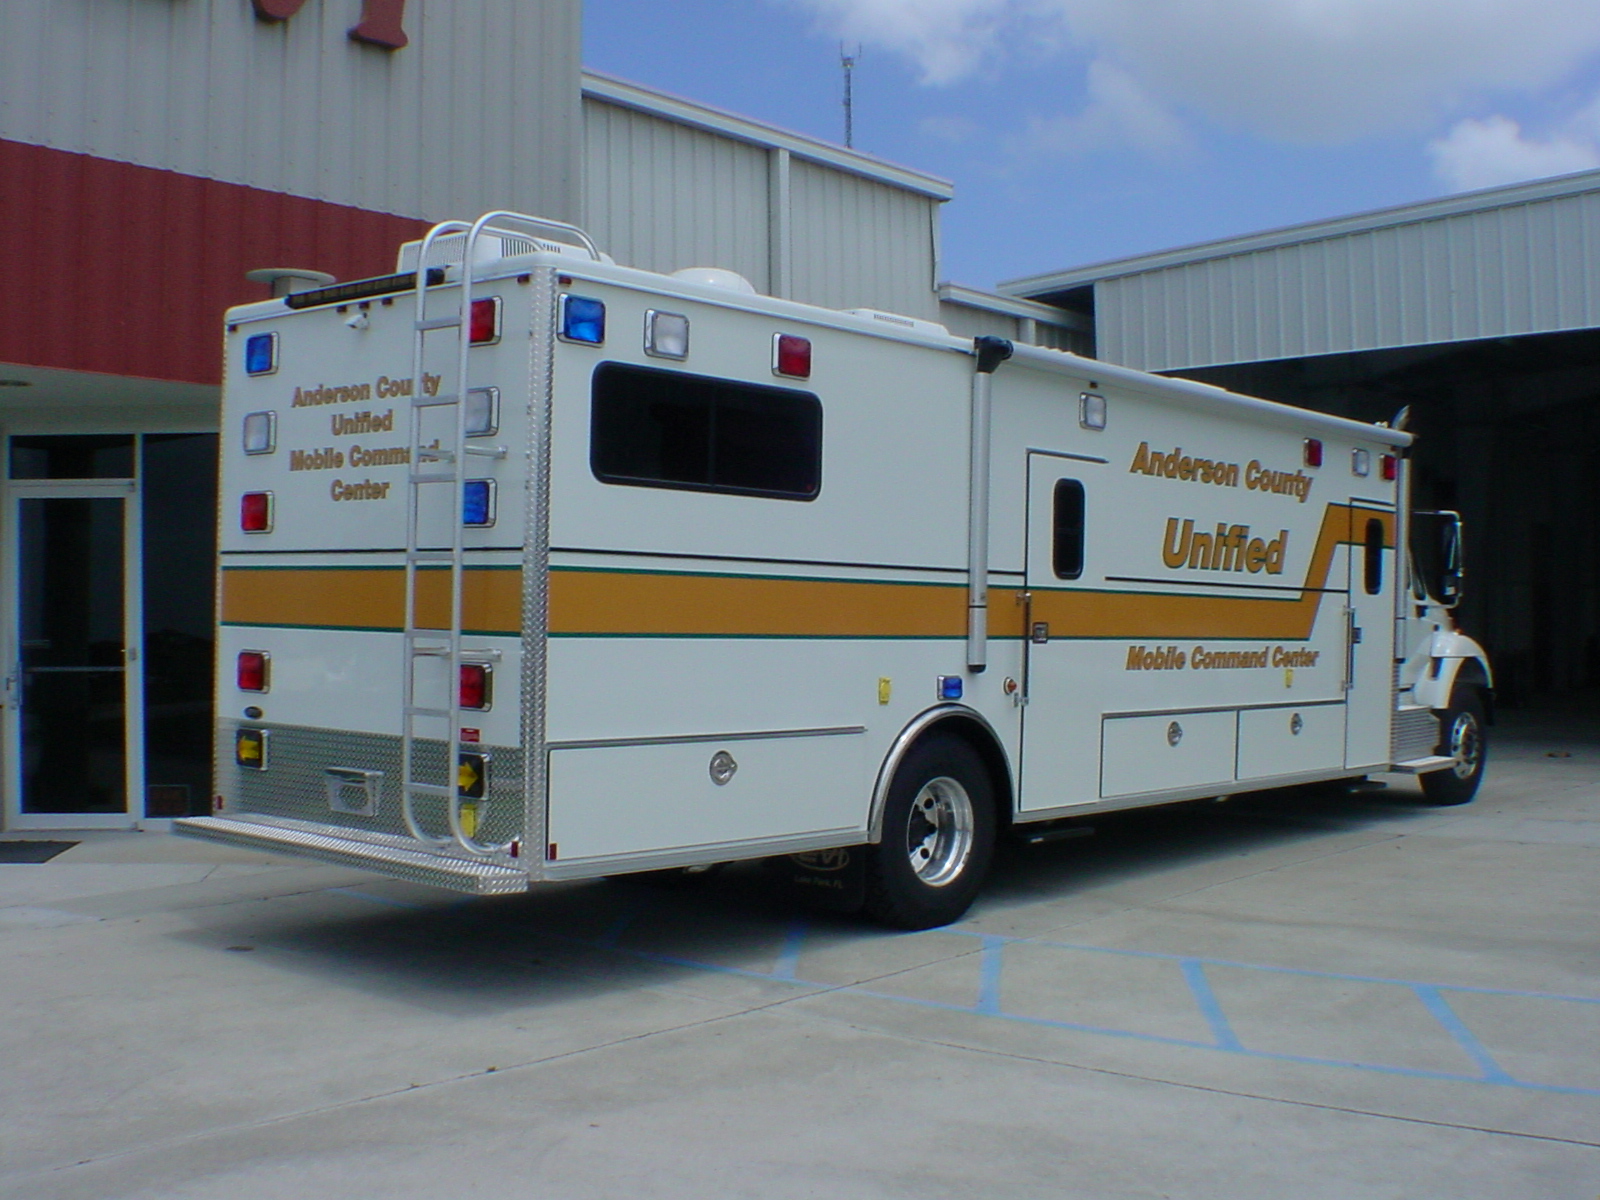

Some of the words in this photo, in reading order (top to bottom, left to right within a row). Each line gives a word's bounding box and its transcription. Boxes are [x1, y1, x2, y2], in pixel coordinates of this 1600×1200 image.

[291, 384, 371, 408] Anderson
[376, 372, 442, 399] Couty
[331, 408, 394, 436] Unified
[289, 447, 344, 471] Mobile
[1129, 441, 1240, 487] Anderson
[1245, 459, 1314, 503] County
[330, 478, 390, 501] Center
[1162, 517, 1290, 575] Unified
[1125, 645, 1187, 671] Mobile
[1190, 645, 1270, 670] Command
[1272, 645, 1320, 668] Center
